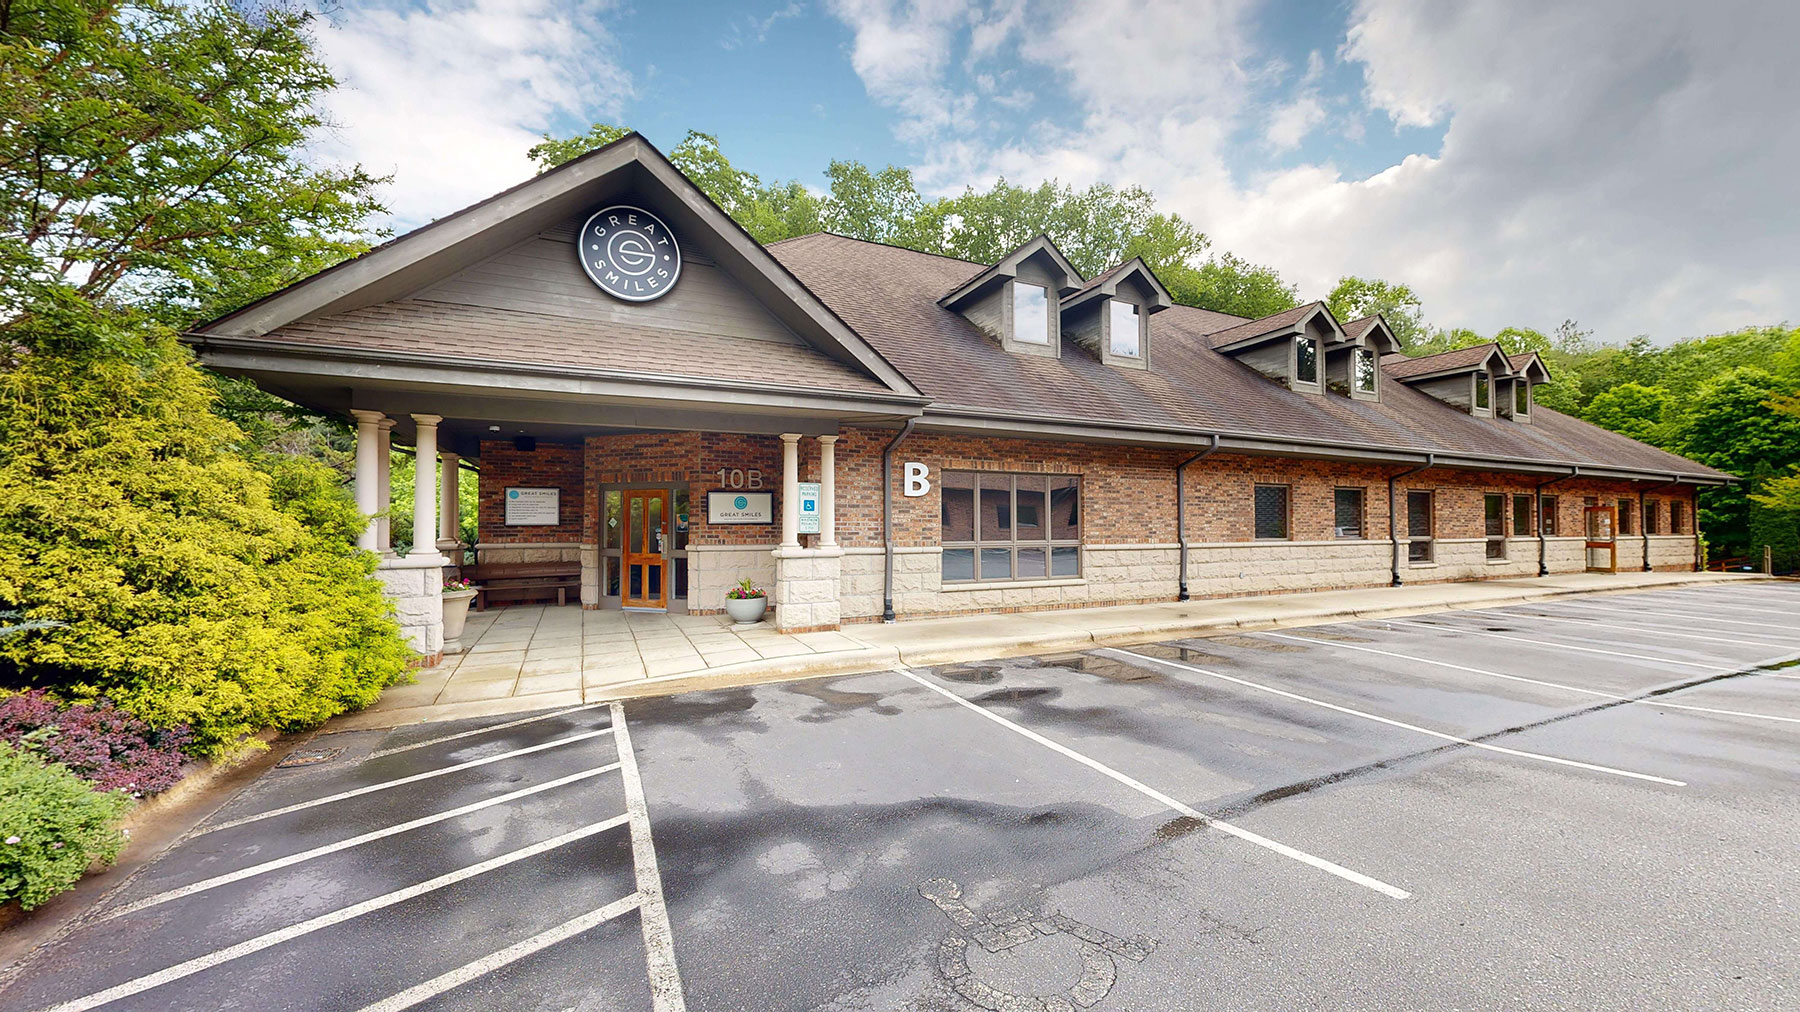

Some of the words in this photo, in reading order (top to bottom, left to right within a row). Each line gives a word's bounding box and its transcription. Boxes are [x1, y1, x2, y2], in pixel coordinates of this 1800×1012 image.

[595, 214, 669, 246] GREAT
[594, 259, 669, 292] SMILES
[717, 468, 763, 489] 10B
[904, 461, 931, 497] B
